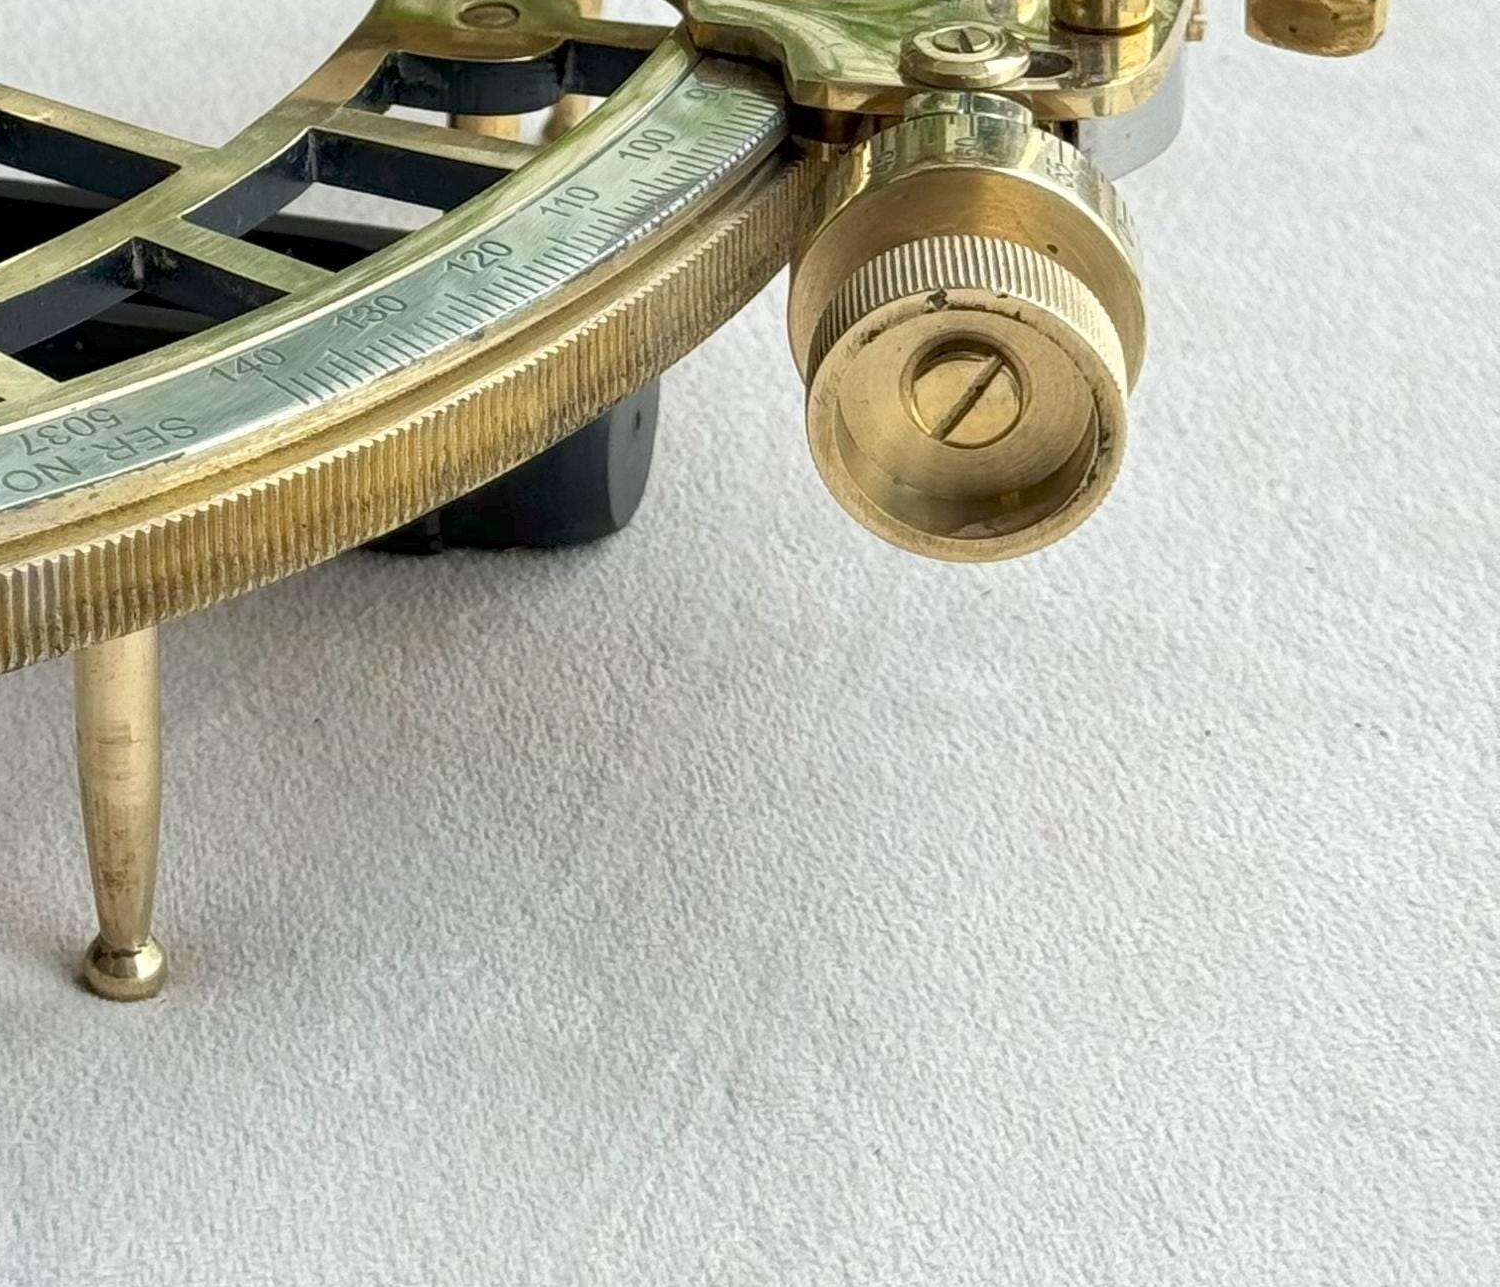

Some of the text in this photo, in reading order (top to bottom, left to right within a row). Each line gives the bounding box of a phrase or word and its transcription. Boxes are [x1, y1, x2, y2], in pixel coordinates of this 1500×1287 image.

[618, 127, 676, 163] 100
[540, 185, 600, 219] 110
[444, 239, 512, 277] 120
[334, 293, 407, 332] 130
[207, 346, 287, 384] 140
[19, 408, 122, 456] 5037
